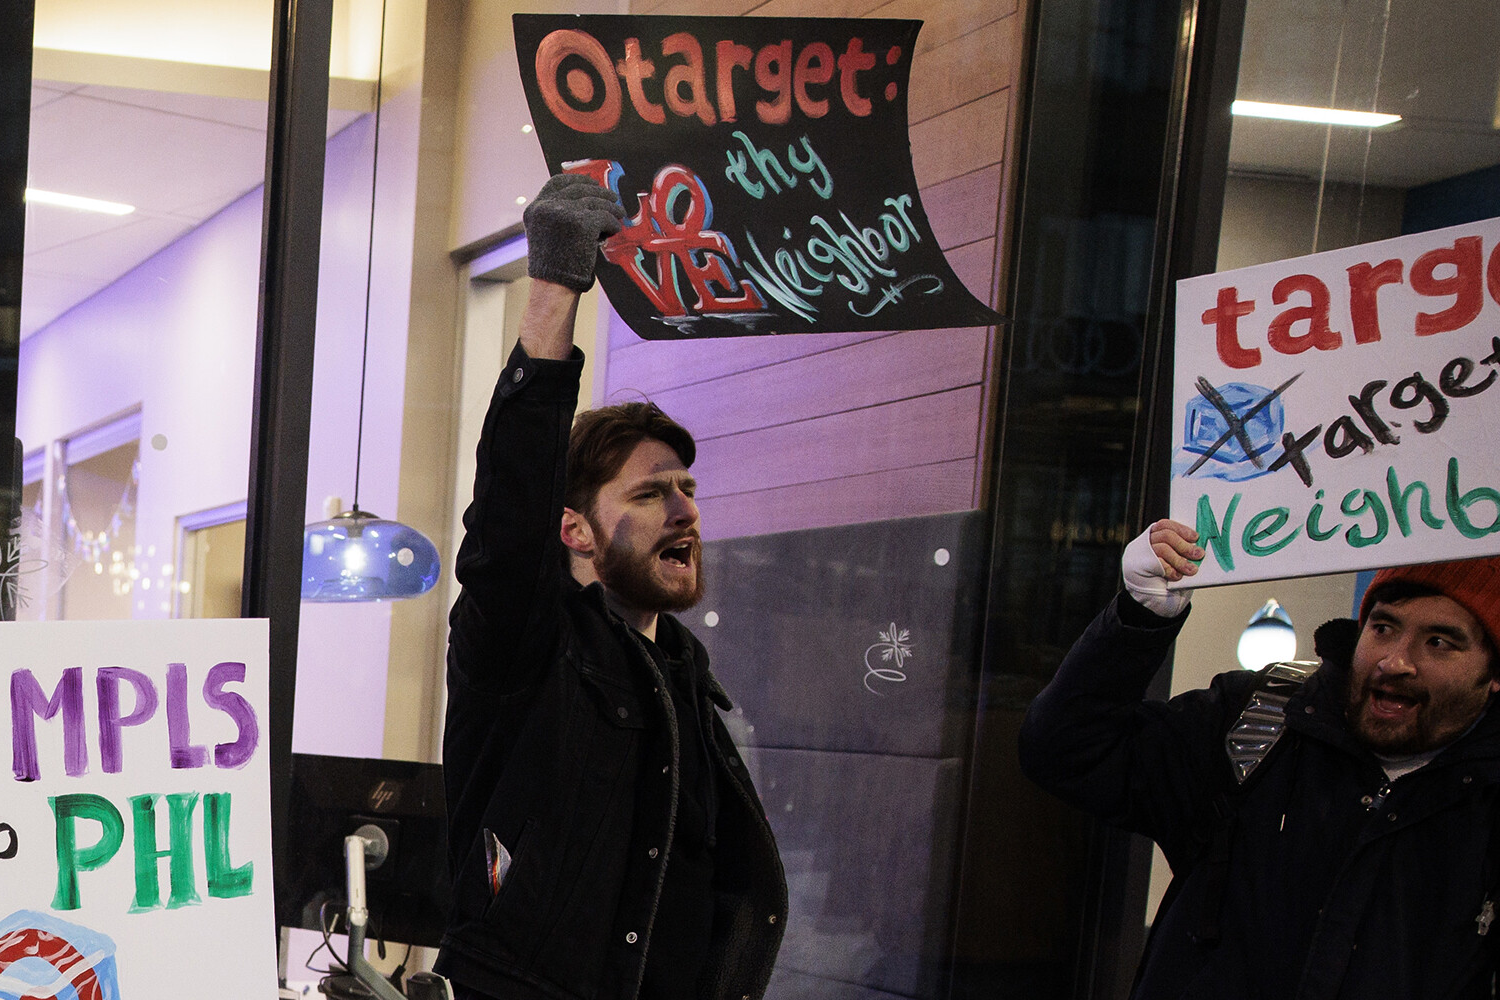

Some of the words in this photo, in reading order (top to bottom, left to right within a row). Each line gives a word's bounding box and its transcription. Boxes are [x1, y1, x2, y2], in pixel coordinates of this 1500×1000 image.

[618, 32, 901, 127] target:
[725, 130, 835, 200] thy
[742, 193, 924, 324] Neighbor
[1202, 235, 1500, 369] targ
[8, 661, 260, 782] MPLS
[47, 792, 254, 914] PHL
